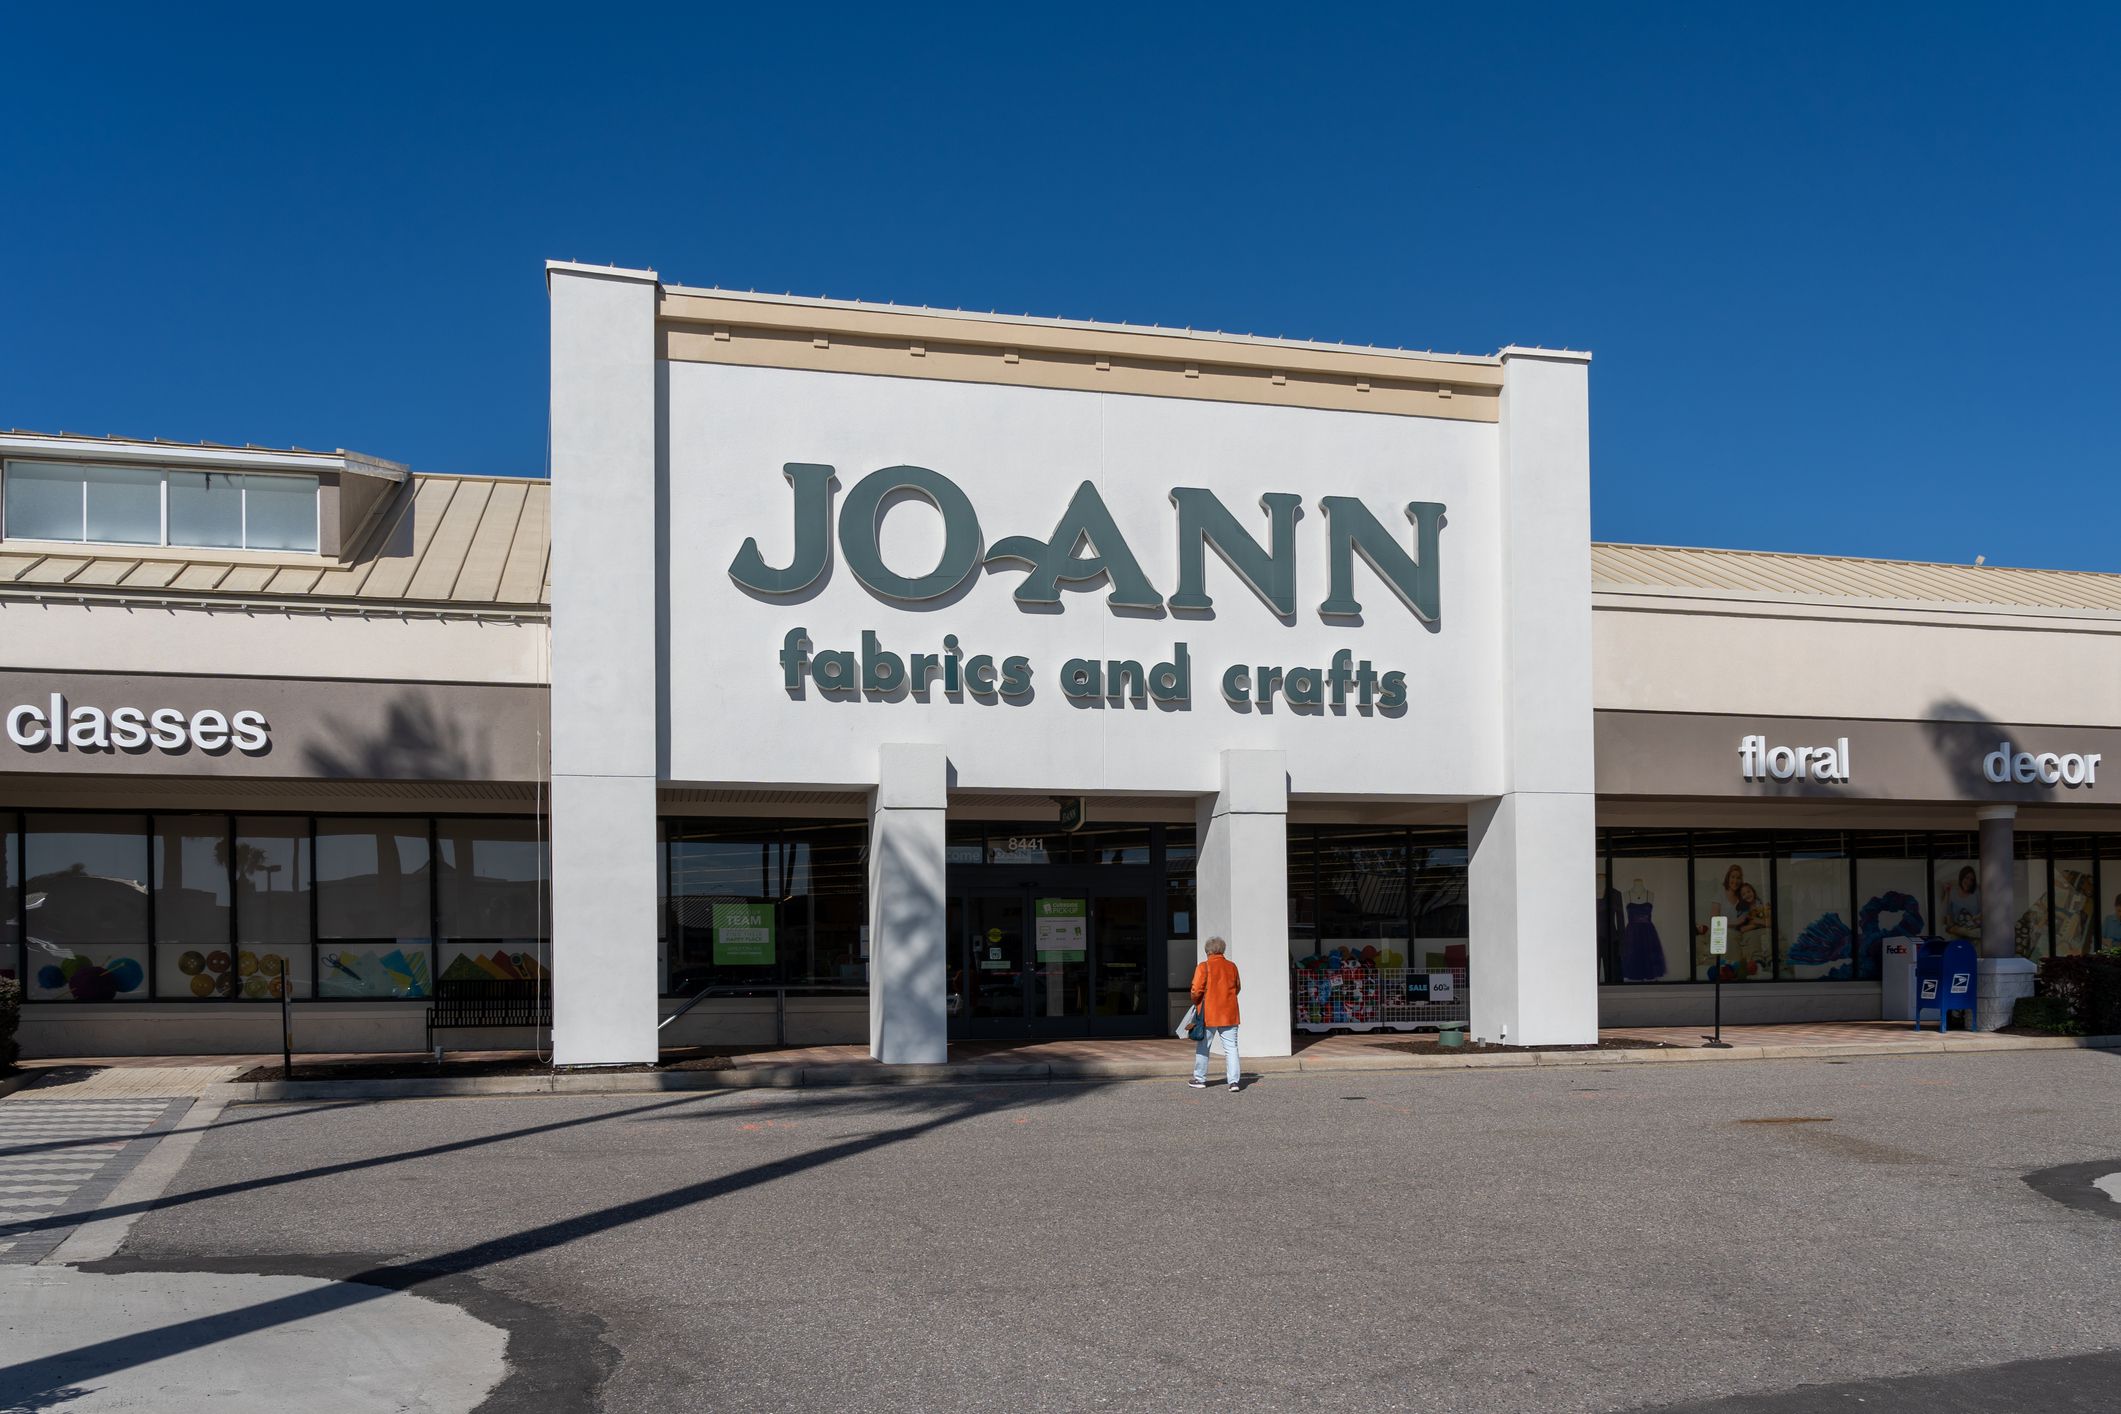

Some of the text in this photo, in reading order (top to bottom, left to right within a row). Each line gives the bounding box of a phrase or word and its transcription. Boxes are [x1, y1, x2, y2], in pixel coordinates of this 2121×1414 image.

[779, 627, 1408, 708] fabrics and crafts
[6, 692, 270, 752] classes
[1738, 735, 1850, 781] floral
[1983, 741, 2102, 785] decor
[1008, 837, 1044, 851] 8441
[727, 915, 761, 925] TEAM
[1886, 944, 1908, 955] FedEx
[1408, 984, 1428, 992] SALE
